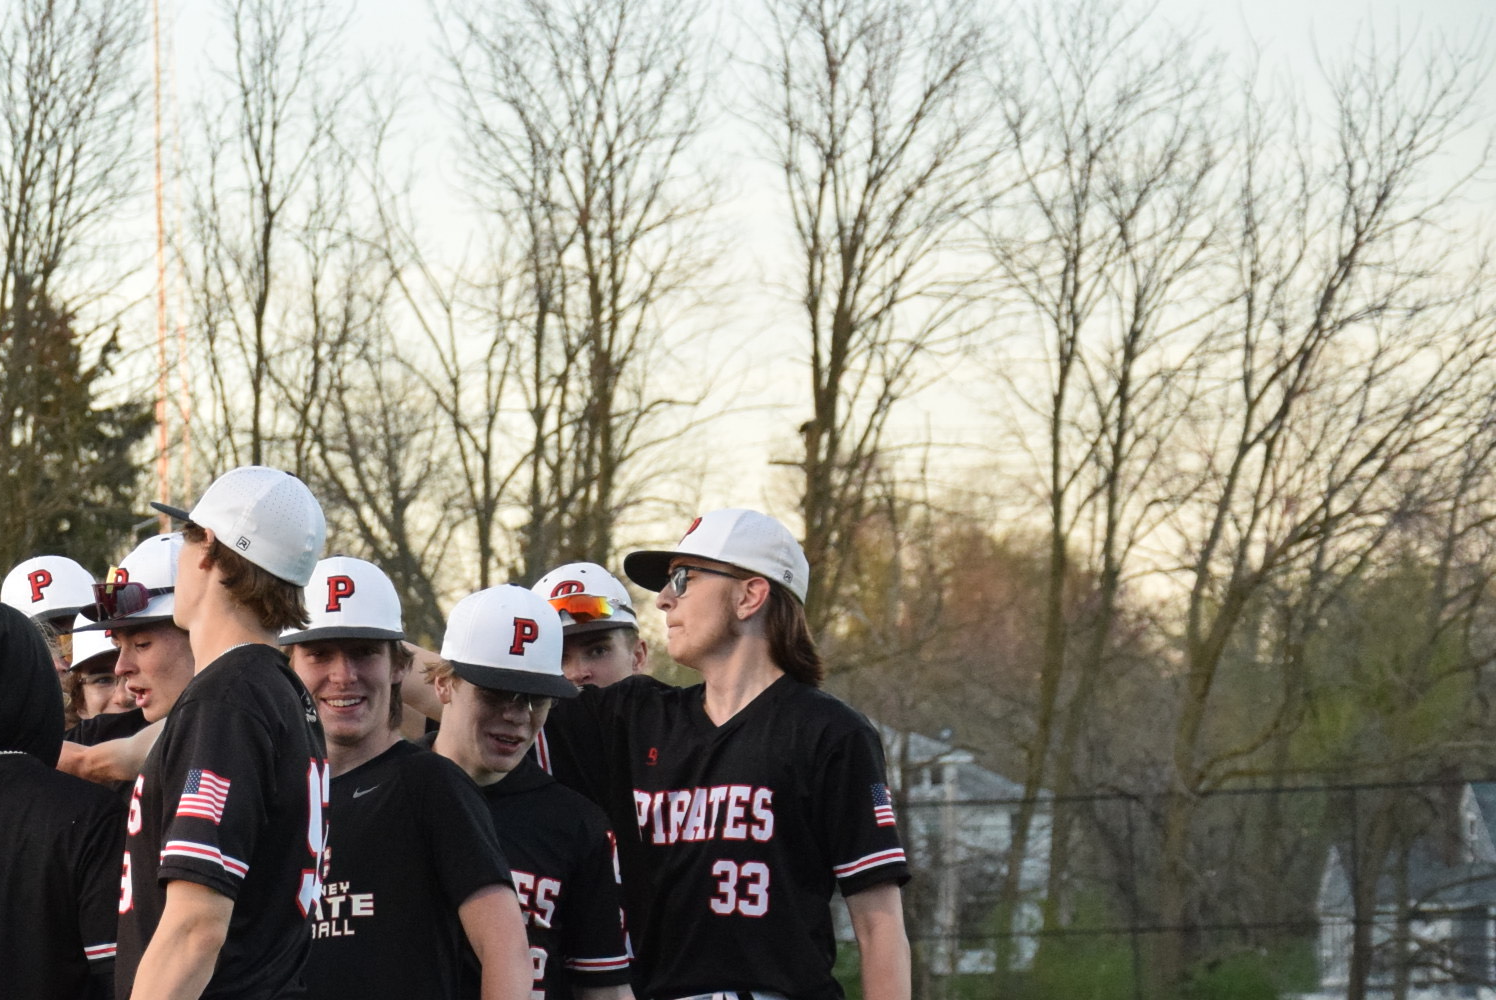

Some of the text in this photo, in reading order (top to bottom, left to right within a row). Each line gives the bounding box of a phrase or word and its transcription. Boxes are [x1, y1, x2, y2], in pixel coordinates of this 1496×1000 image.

[27, 569, 53, 603] P
[326, 575, 355, 612] P
[509, 617, 539, 656] P
[632, 784, 774, 846] PIRATES
[510, 869, 562, 929] ES
[710, 858, 770, 917] 33
